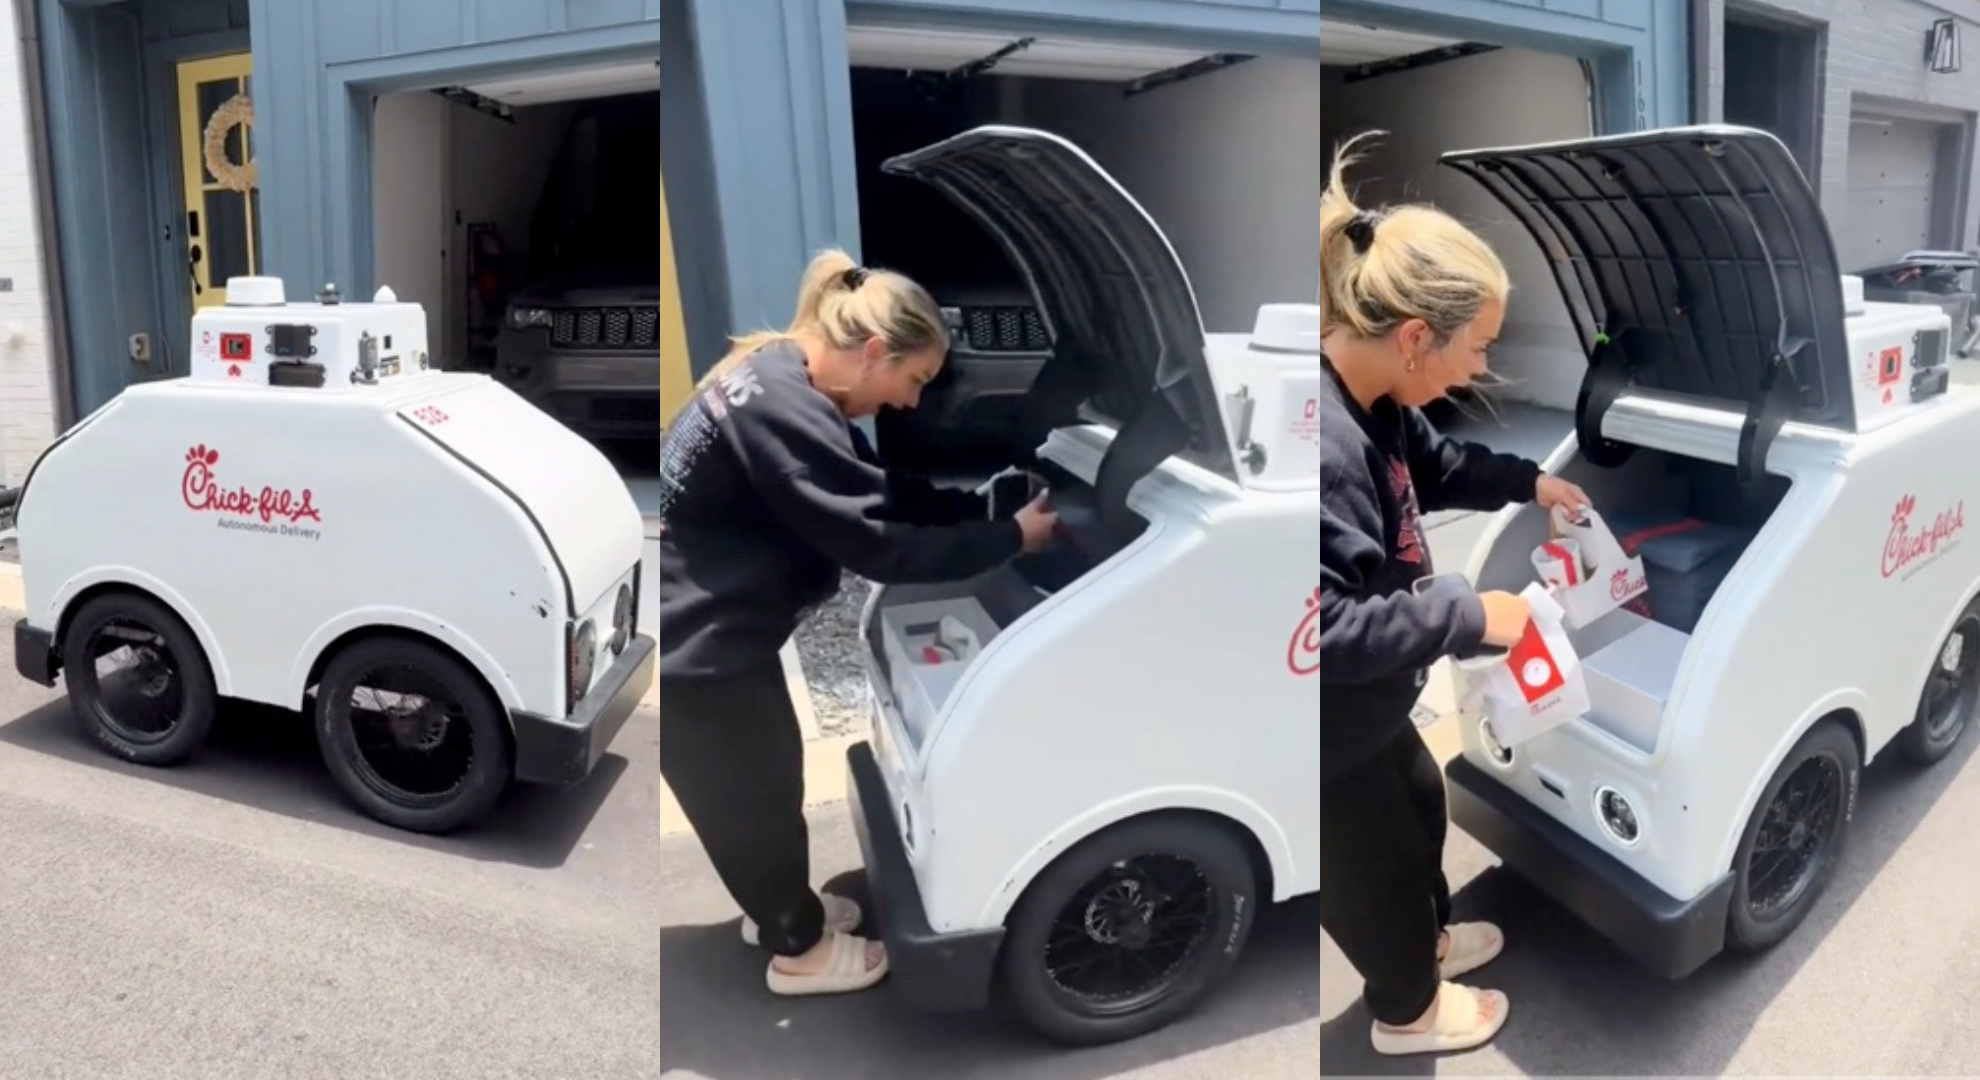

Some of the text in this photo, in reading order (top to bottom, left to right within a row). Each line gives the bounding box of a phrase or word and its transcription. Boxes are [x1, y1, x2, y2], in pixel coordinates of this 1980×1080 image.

[182, 444, 321, 523] Chick-fil-A
[217, 518, 321, 541] Autonomous Delivery
